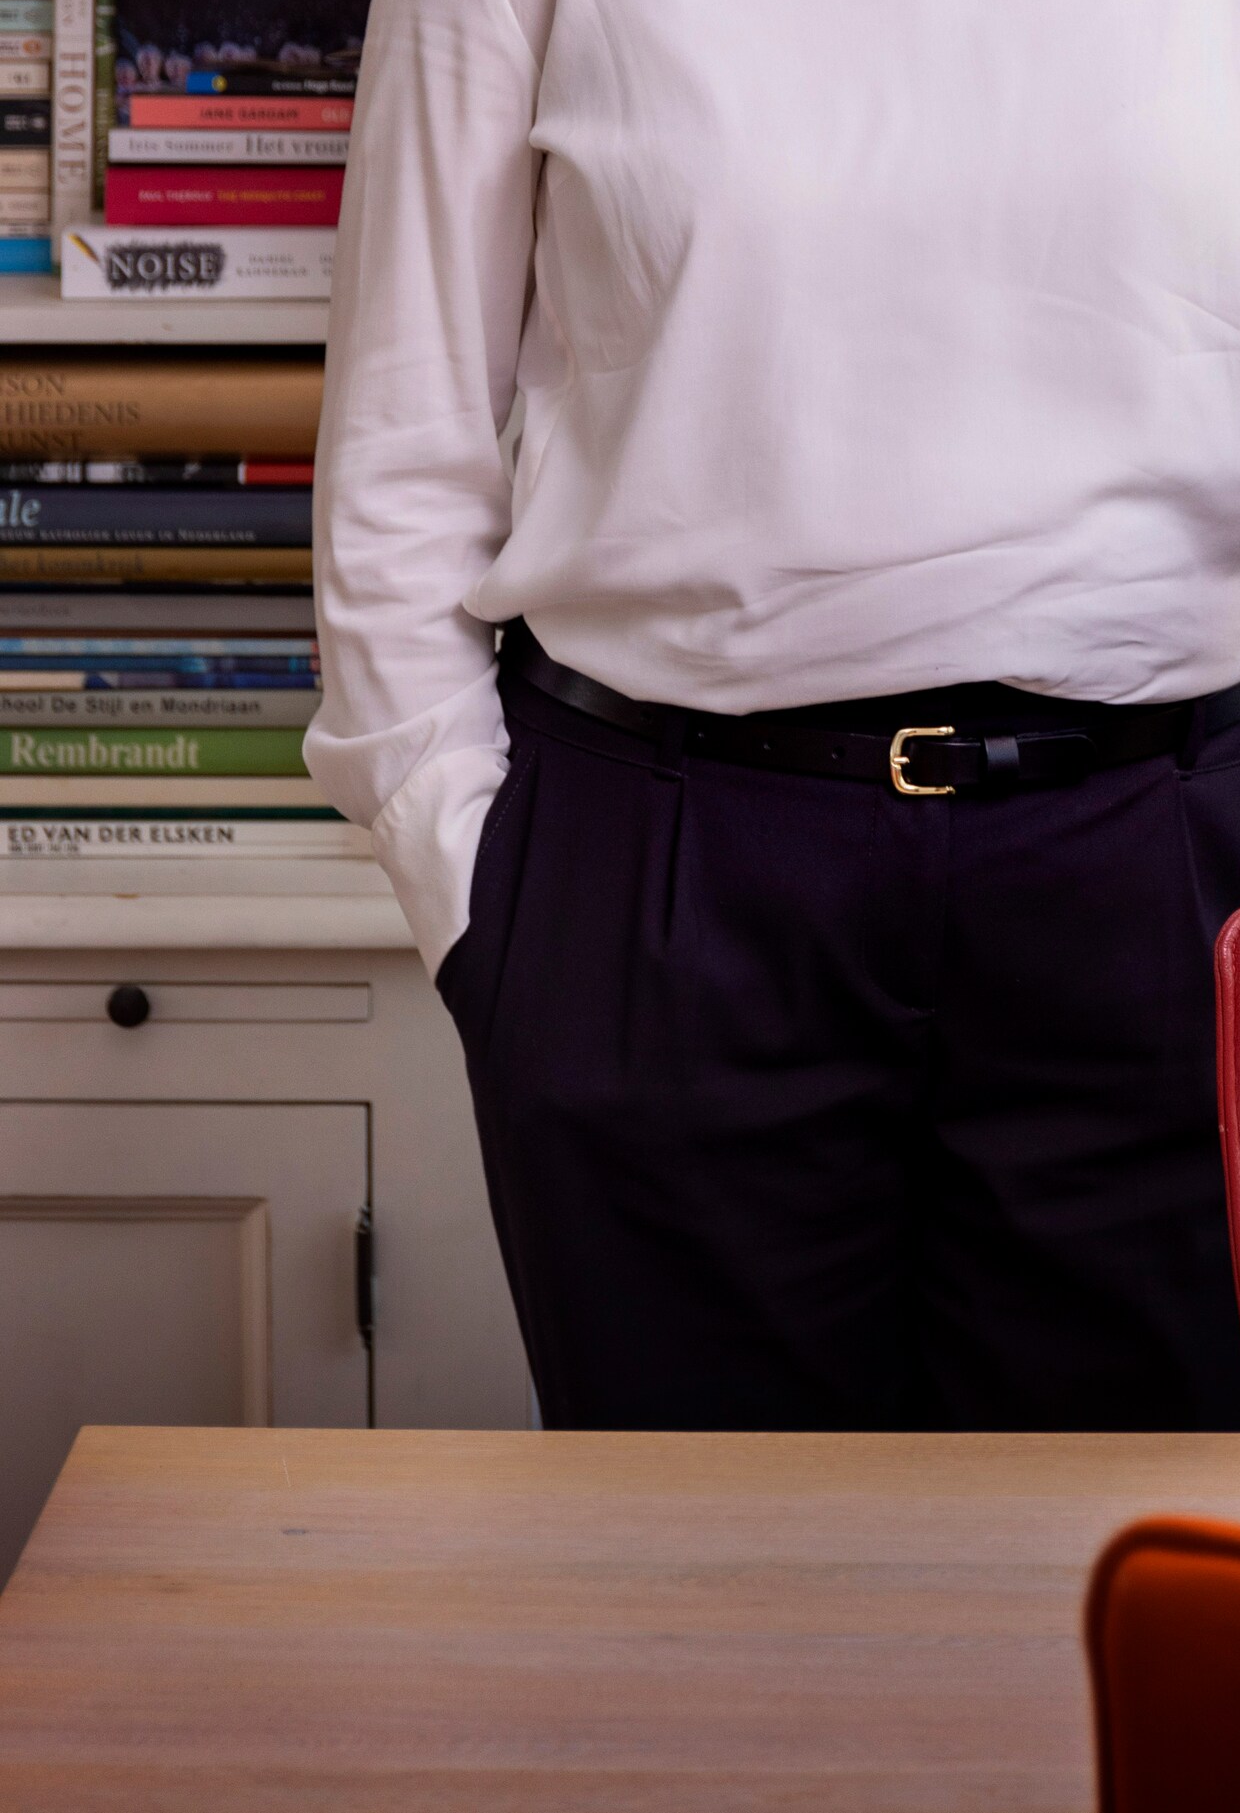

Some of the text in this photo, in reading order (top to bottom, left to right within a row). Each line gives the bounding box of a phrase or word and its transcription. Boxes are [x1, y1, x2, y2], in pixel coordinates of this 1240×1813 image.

[58, 50, 87, 184] HOME
[200, 107, 234, 120] JANE
[246, 134, 286, 155] Het
[110, 252, 220, 280] NOISE
[0, 373, 65, 397] SON
[0, 428, 81, 452] UNST
[51, 697, 77, 712] De
[85, 696, 124, 716] Stijl
[130, 700, 153, 712] en
[160, 696, 262, 713] Mondriaan
[10, 732, 200, 769] Rembrandt
[8, 826, 235, 845] ED VAN DER ELSKEN
